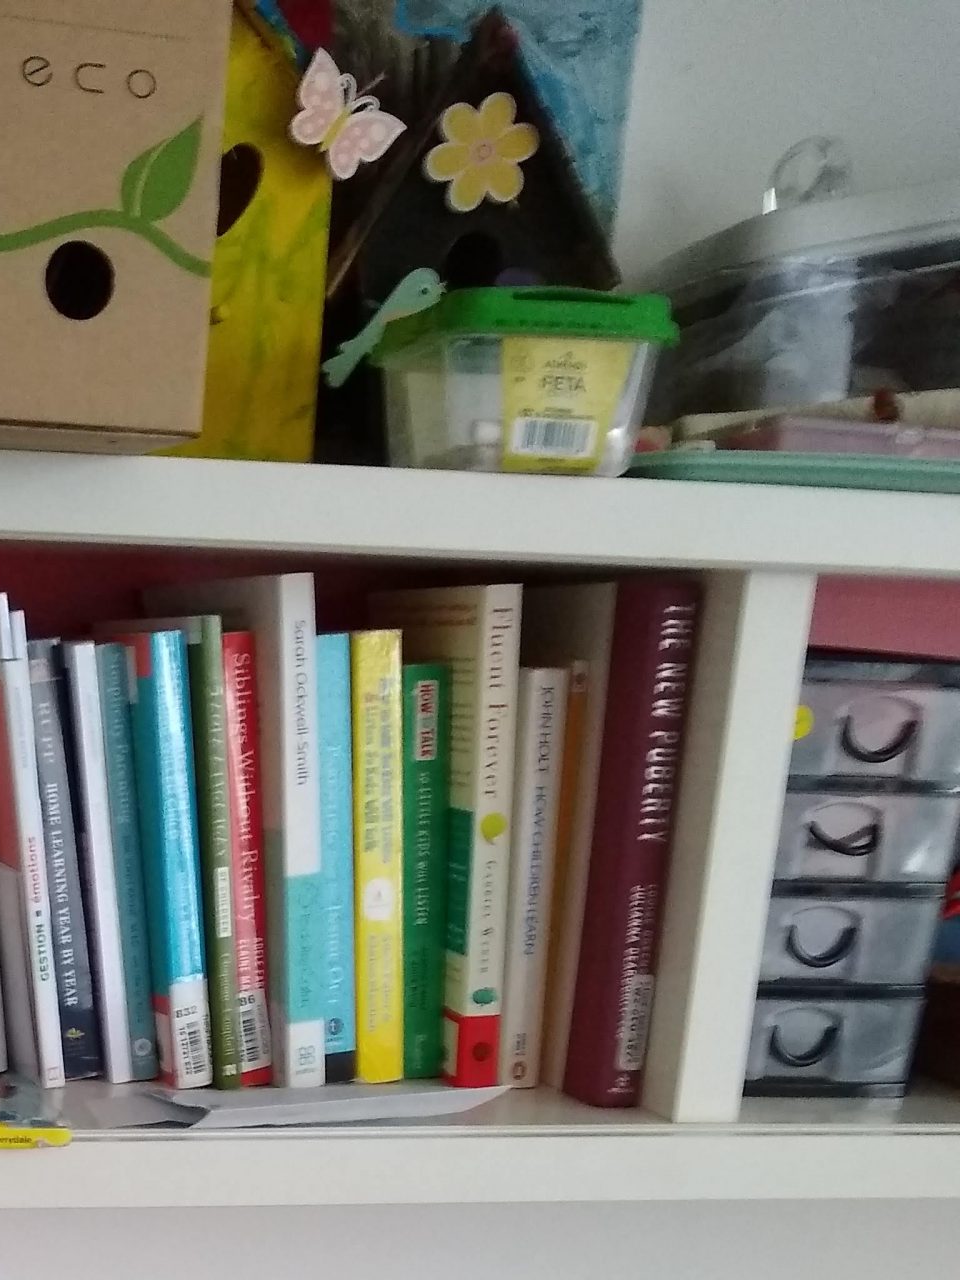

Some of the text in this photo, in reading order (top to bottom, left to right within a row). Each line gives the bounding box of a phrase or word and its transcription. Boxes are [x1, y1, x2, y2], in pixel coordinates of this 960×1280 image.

[21, 54, 157, 99] eco
[540, 374, 587, 393] FETA
[293, 619, 310, 787] Sarah Ockwell-Smith
[419, 683, 436, 714] HOW
[419, 728, 436, 758] TALK
[483, 606, 515, 799] Fluent Forever
[535, 685, 556, 774] JOHN HOLT
[635, 602, 697, 842] THE NEW PUBERTY
[232, 652, 262, 923] Siblings Without Rivalry
[26, 836, 50, 982] GESTION émotions
[43, 782, 80, 1008] HOME LEARNING YEAR BY YEAR
[413, 887, 430, 926] LISTEN
[522, 785, 548, 956] HOW CHILDREN LEARN
[253, 937, 265, 967] ADELE
